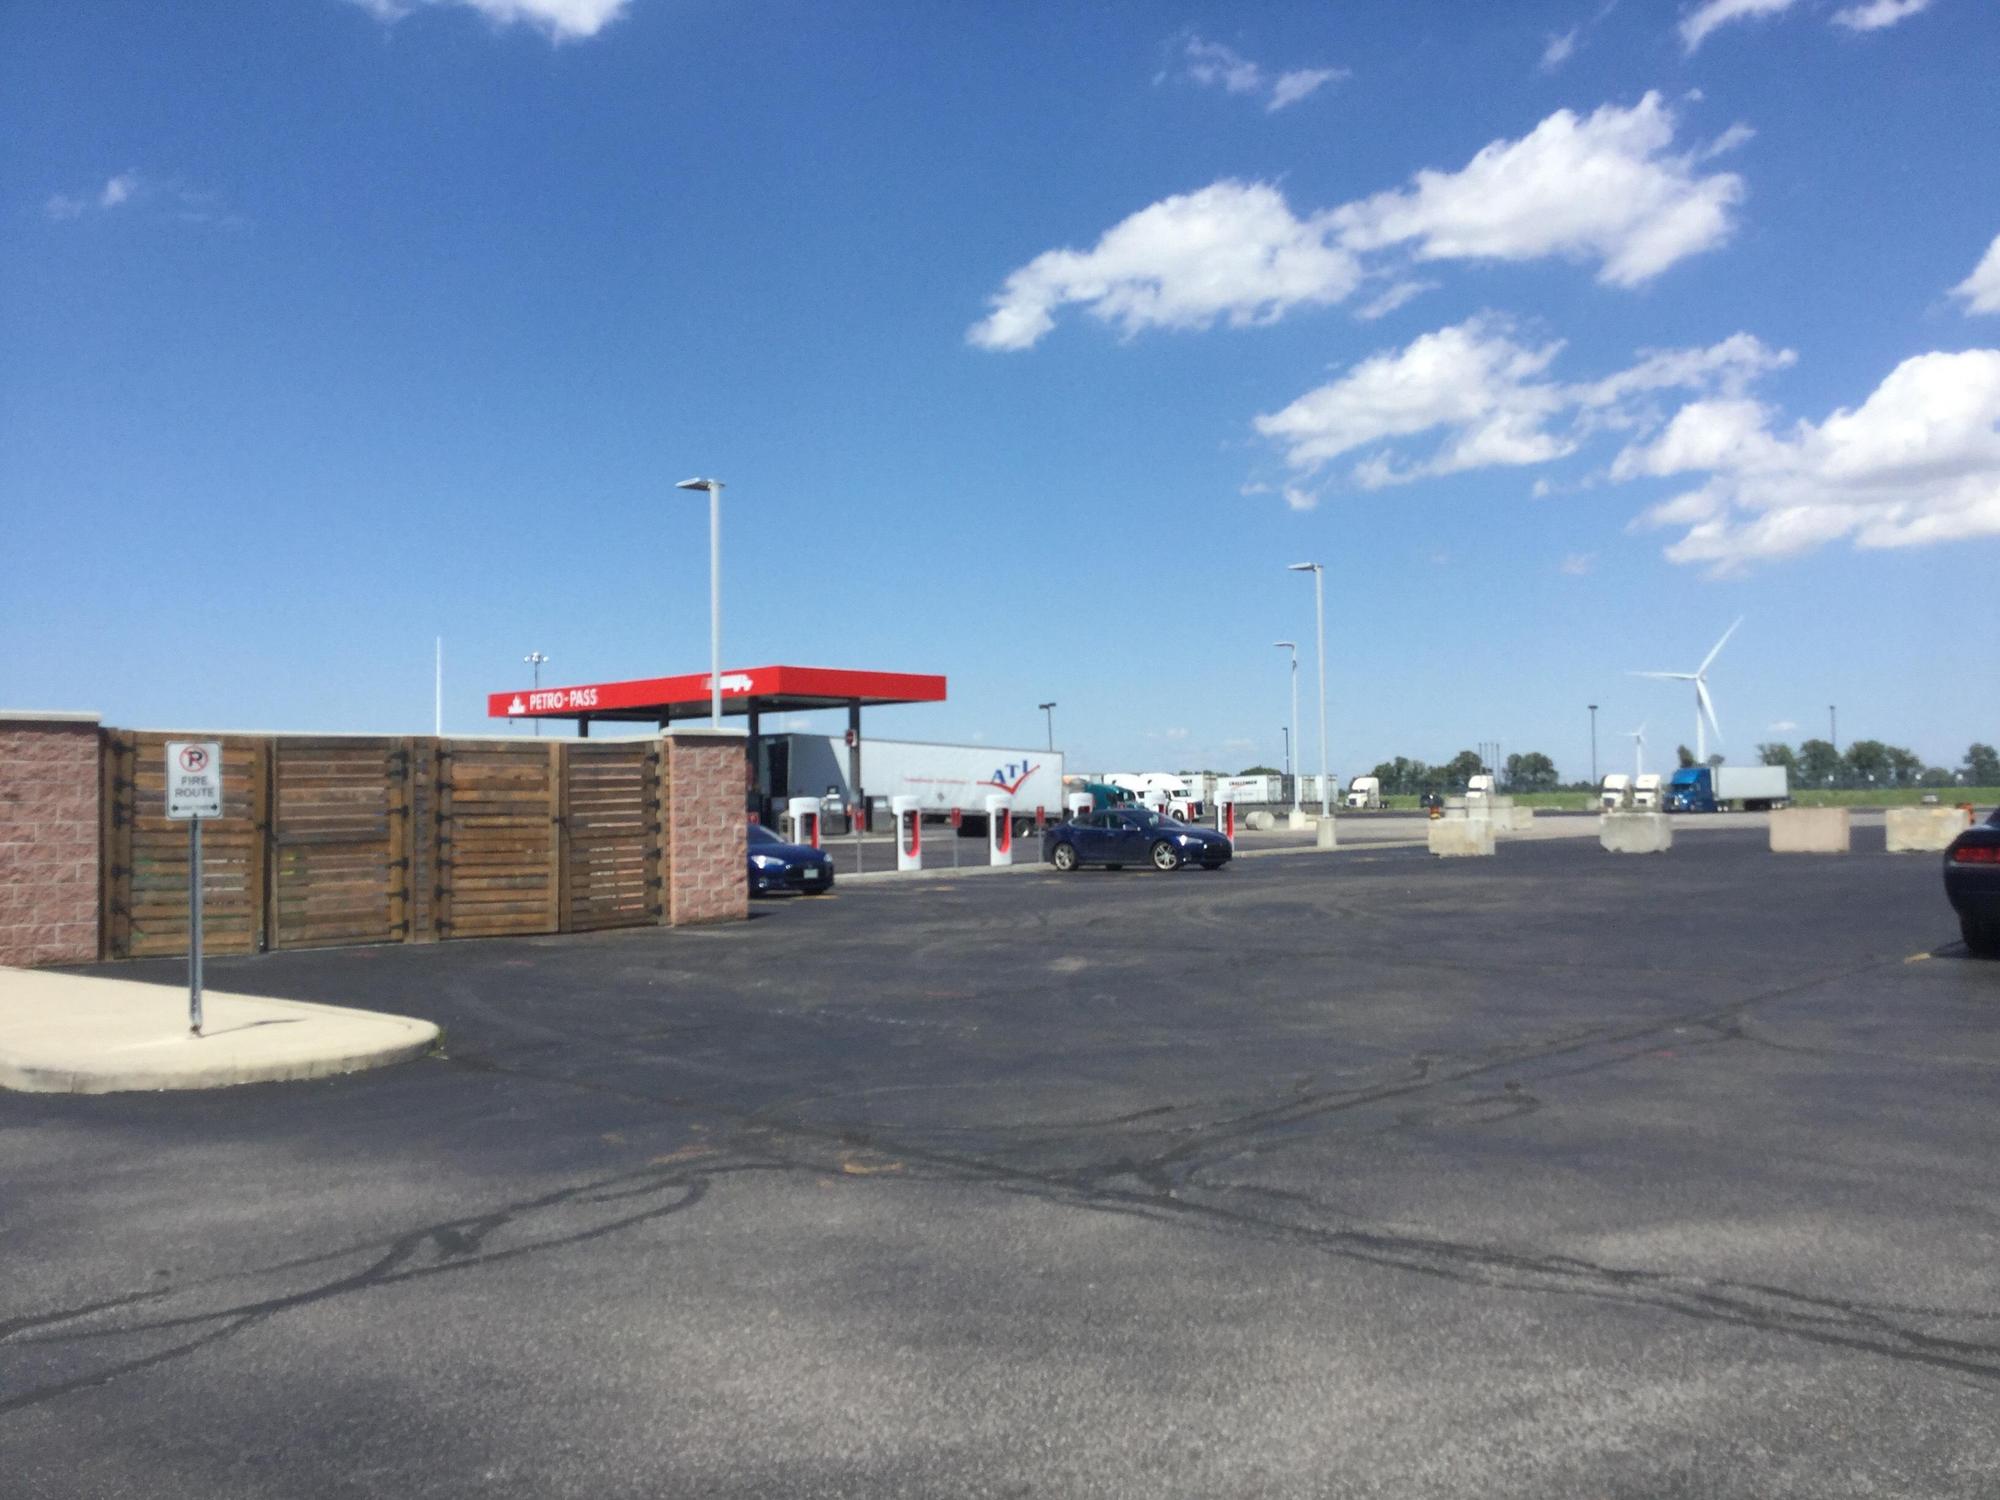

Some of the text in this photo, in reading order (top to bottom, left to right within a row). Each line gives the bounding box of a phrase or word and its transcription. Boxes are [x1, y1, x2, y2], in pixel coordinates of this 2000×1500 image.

[529, 688, 598, 711] PETRO-PASS
[181, 775, 208, 786] FIRE
[990, 759, 1028, 785] ATI
[174, 787, 215, 798] ROUTE
